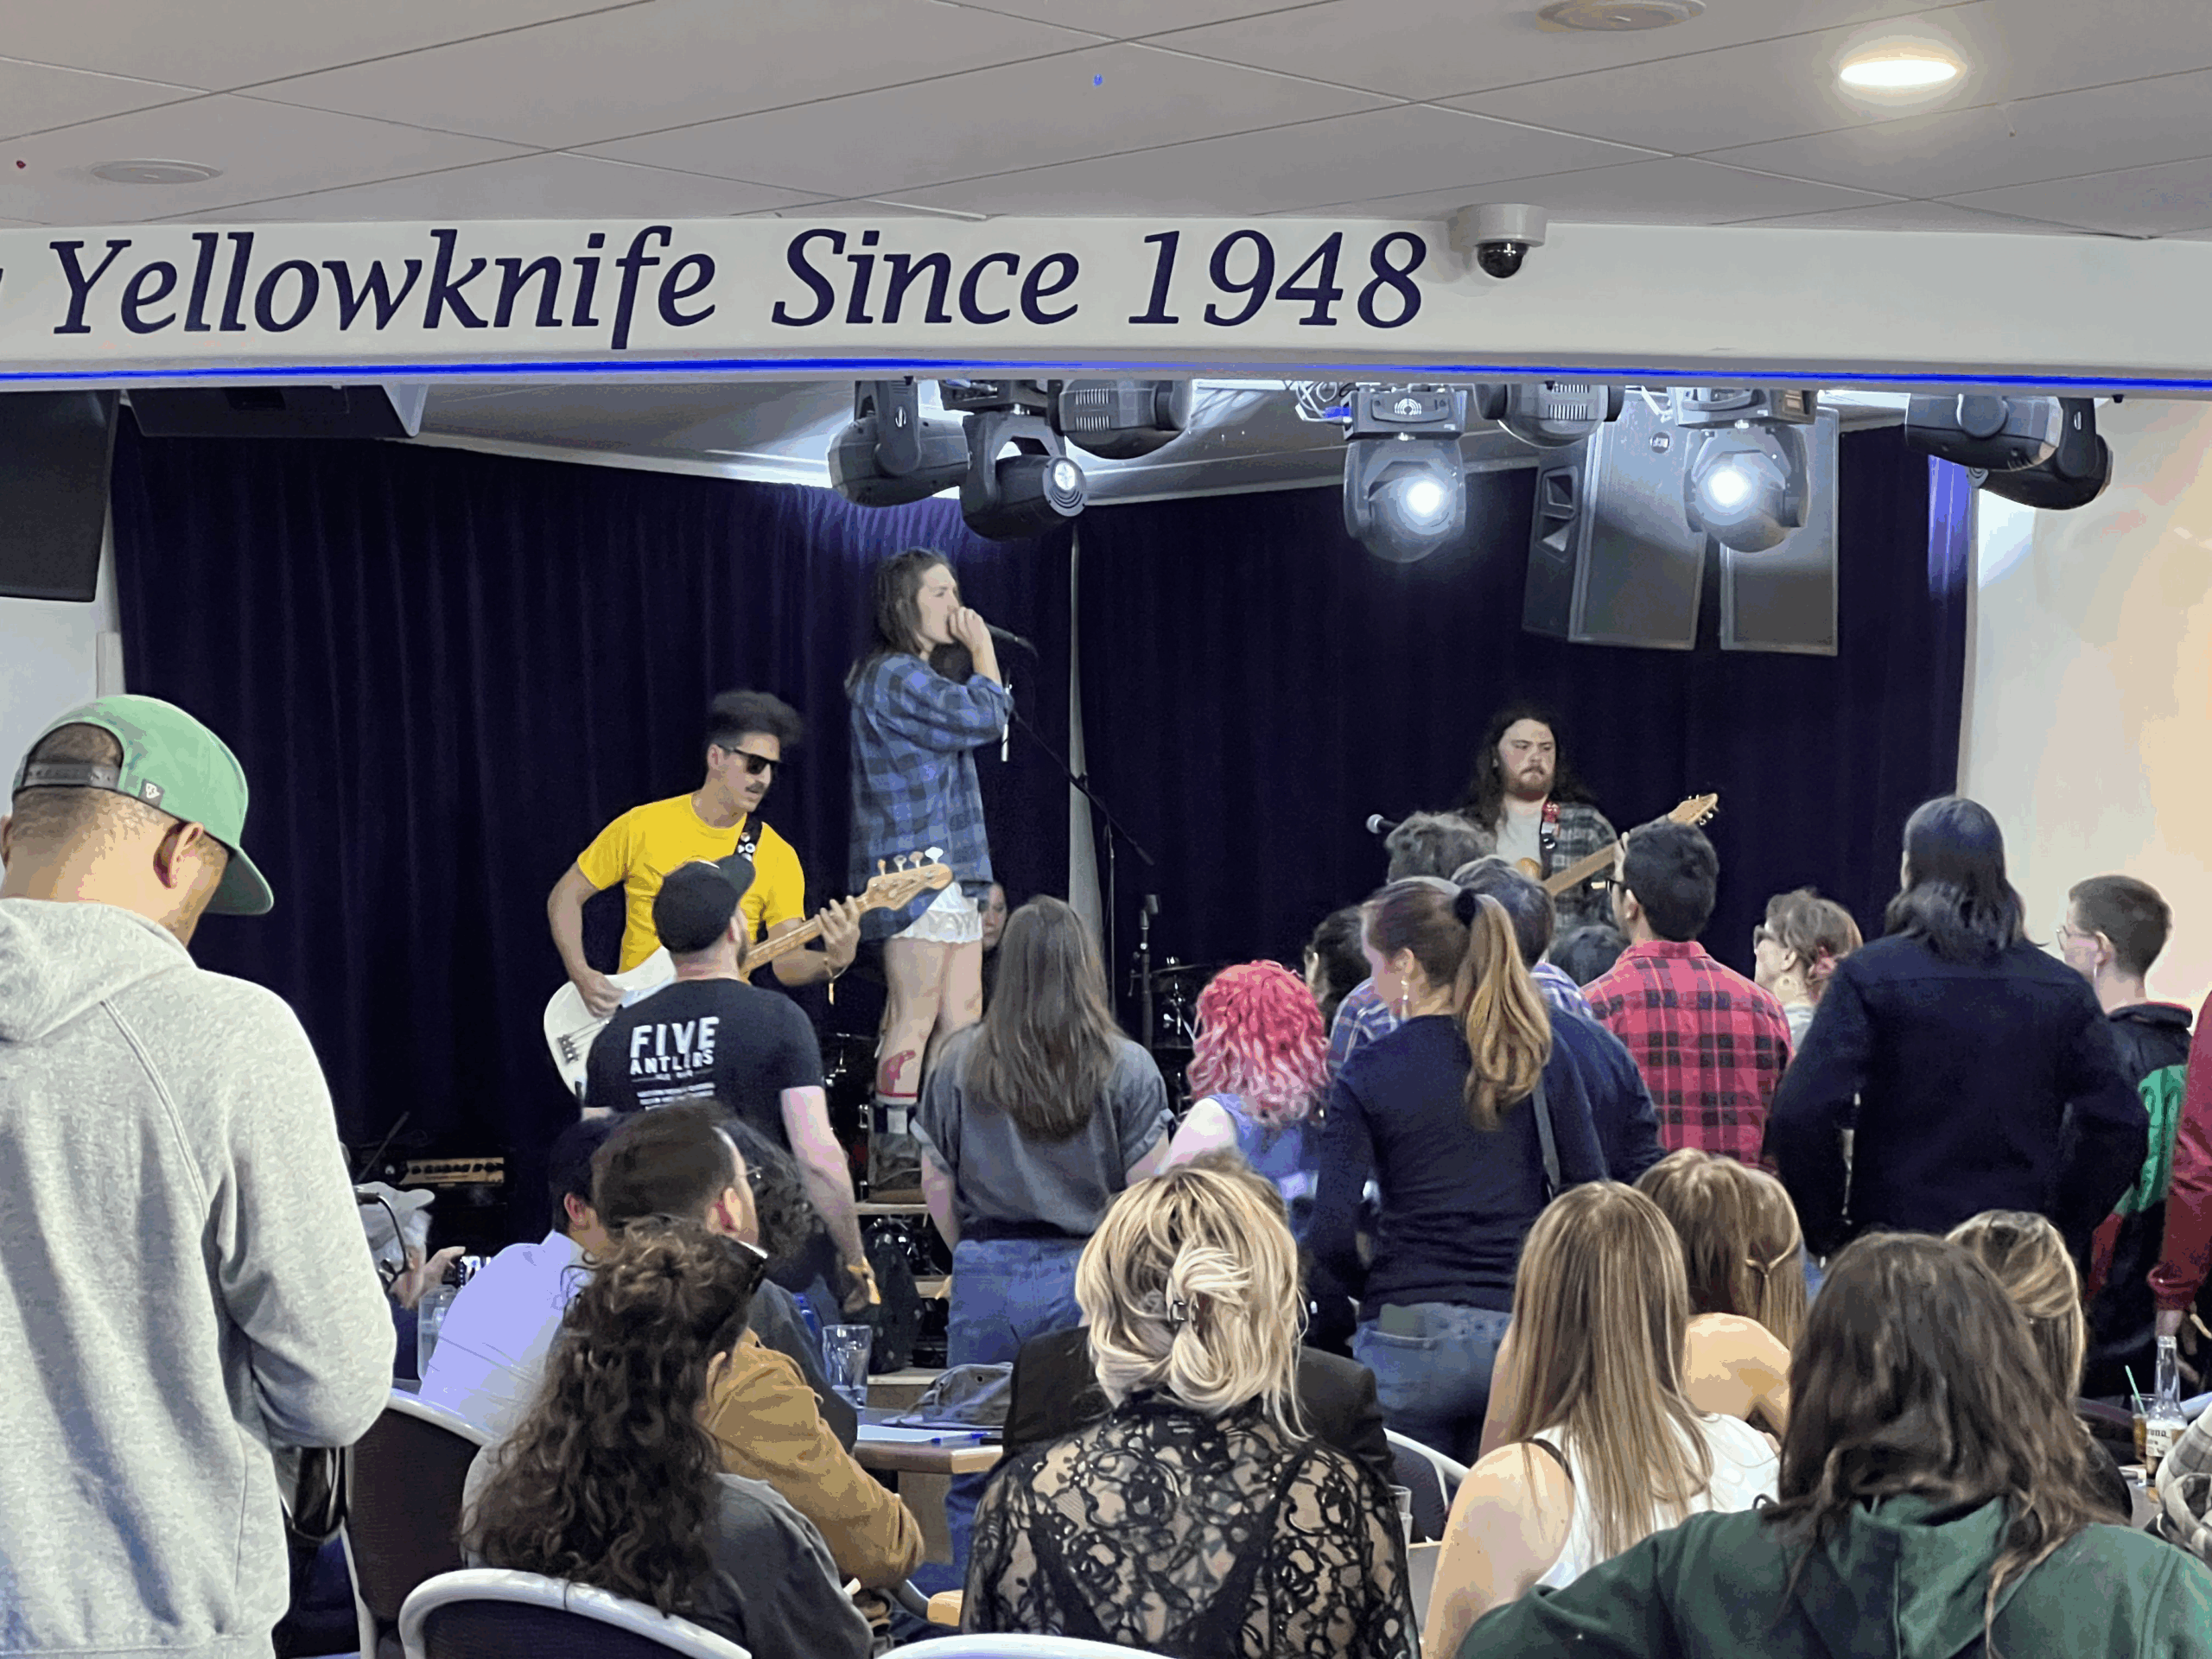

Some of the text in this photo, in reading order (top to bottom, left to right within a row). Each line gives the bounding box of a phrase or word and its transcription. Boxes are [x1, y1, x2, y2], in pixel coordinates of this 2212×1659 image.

[49, 225, 1427, 350] Yellowknife Since 1948
[629, 1016, 720, 1058] FIVE
